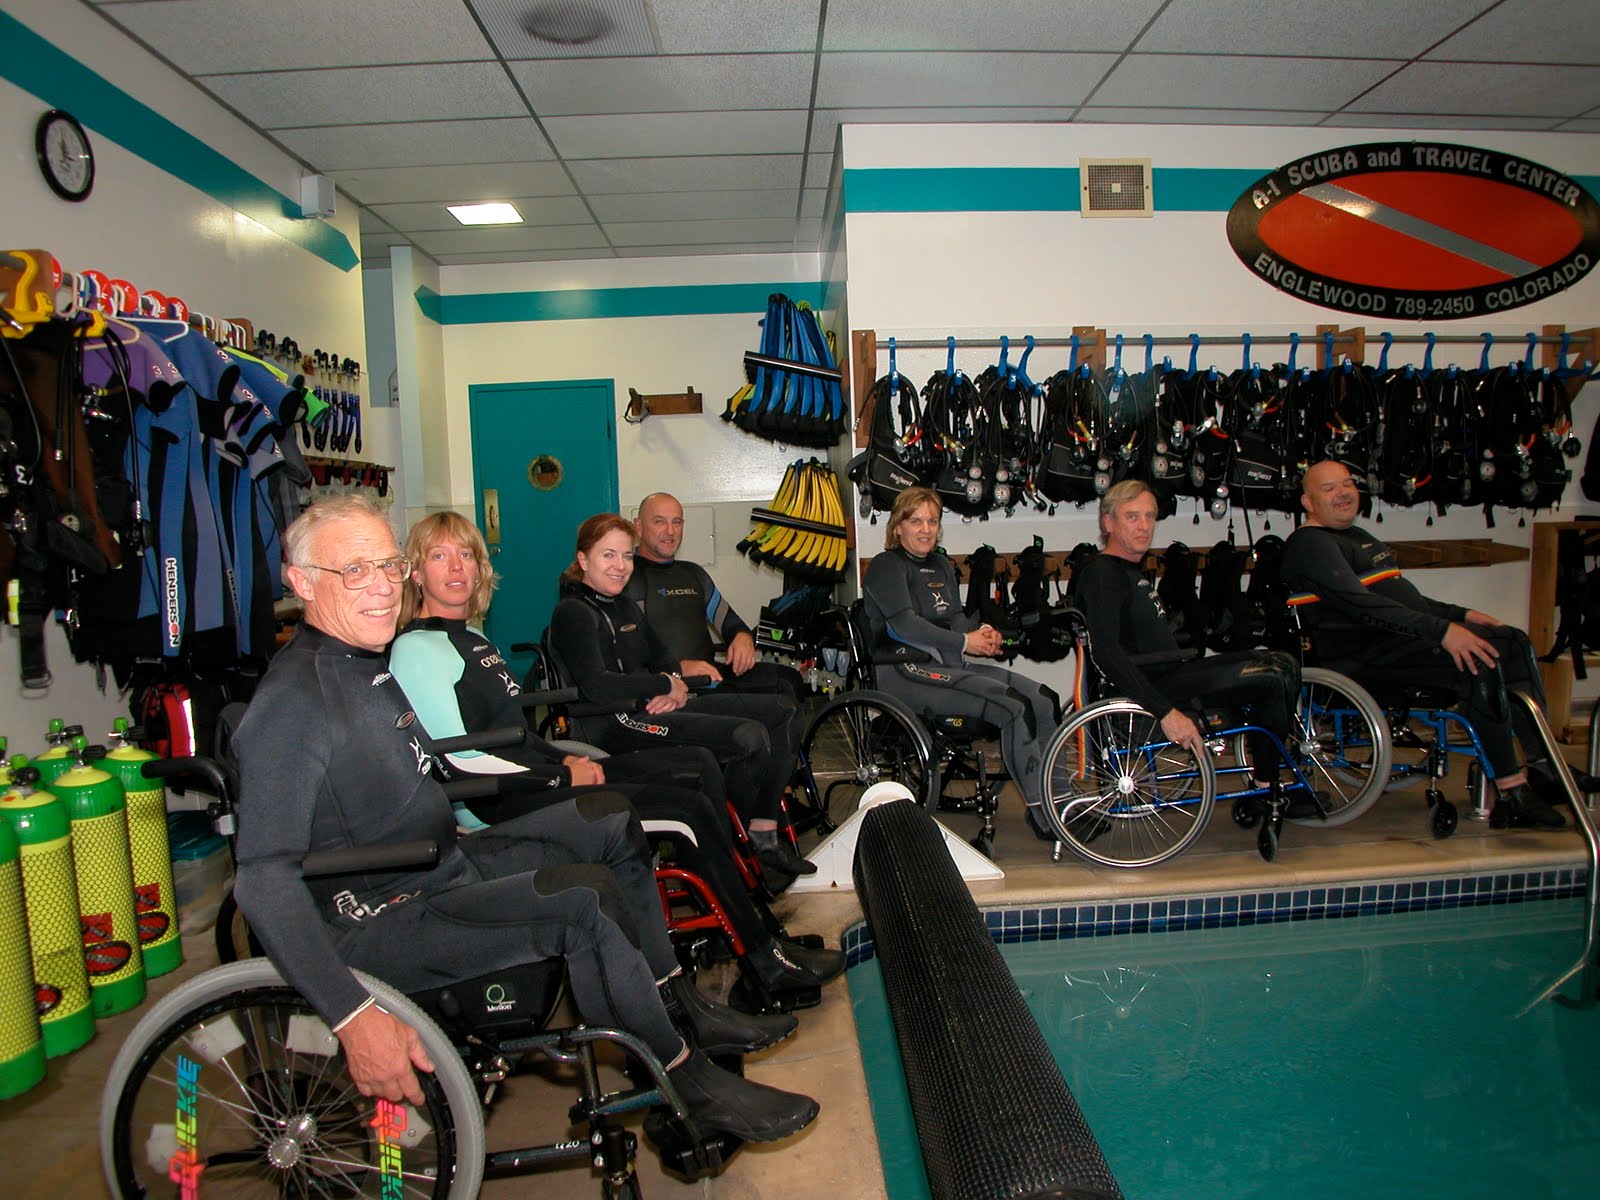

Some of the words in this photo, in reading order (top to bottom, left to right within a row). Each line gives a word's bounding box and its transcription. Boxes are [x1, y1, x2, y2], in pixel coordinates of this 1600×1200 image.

[1251, 178, 1281, 211] A-1
[1289, 150, 1359, 187] SCUBA
[1366, 147, 1401, 168] and
[1412, 146, 1492, 173] TRAVEL
[1503, 160, 1581, 207] CENTER
[1254, 252, 1387, 313] ENGLEWOOD
[1394, 295, 1475, 315] 789-2450
[1485, 253, 1590, 310] COLORADO
[216, 349, 229, 361] 3
[152, 365, 163, 376] 3
[167, 362, 179, 374] 3
[1118, 368, 1125, 377] 6
[892, 370, 899, 379] 1
[956, 370, 963, 379] 2
[1010, 375, 1016, 383] 3
[165, 557, 181, 648] HENDERSON
